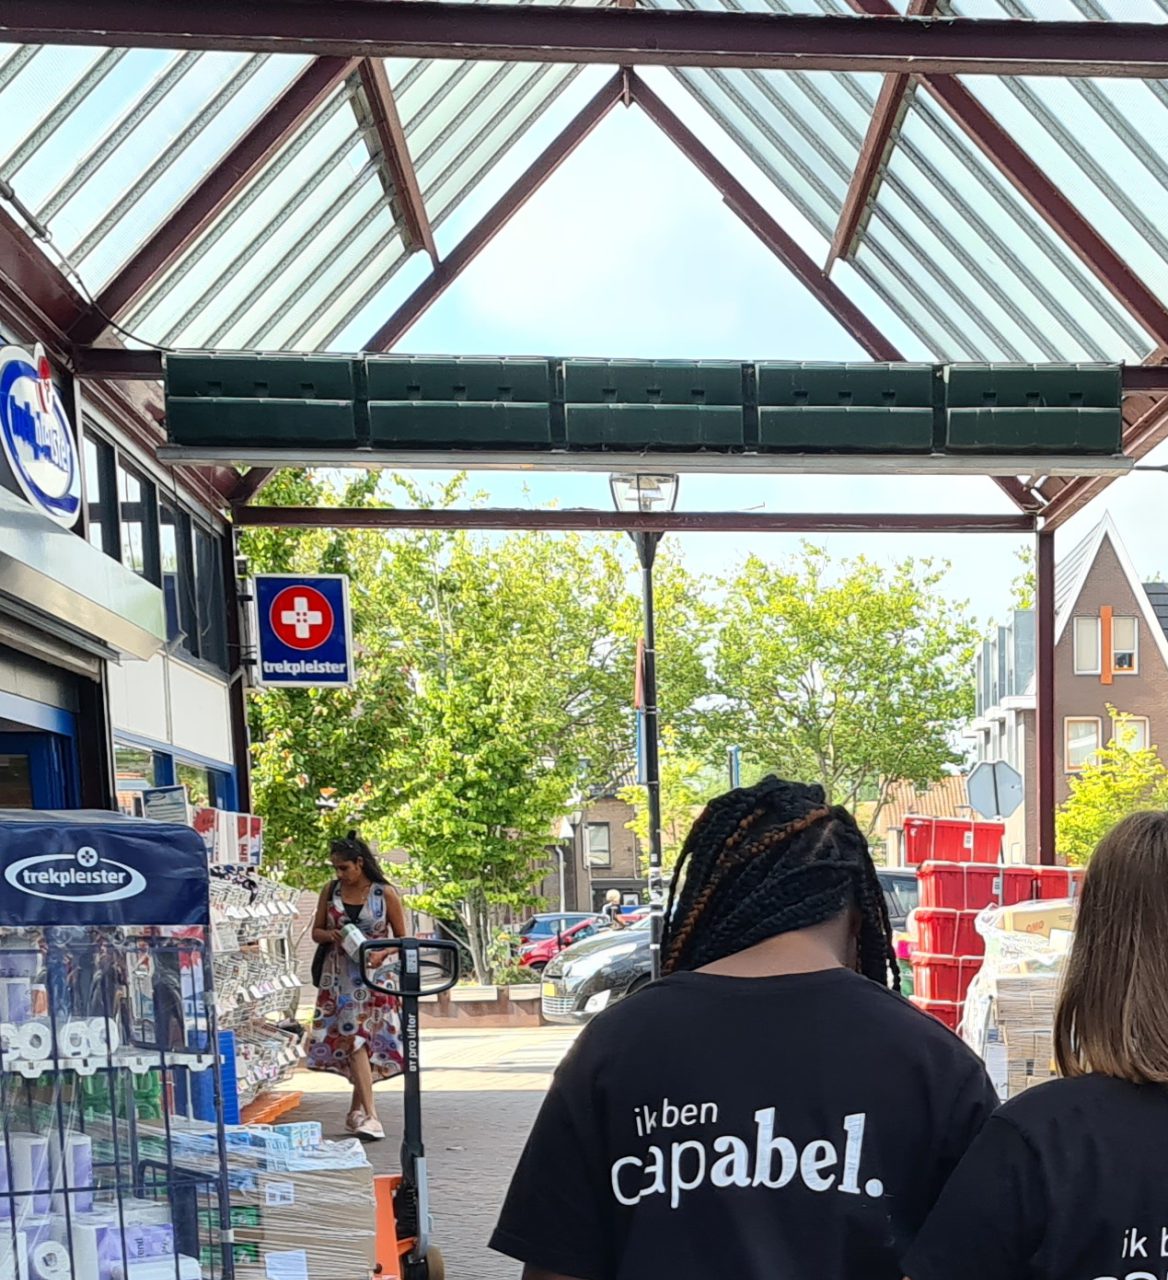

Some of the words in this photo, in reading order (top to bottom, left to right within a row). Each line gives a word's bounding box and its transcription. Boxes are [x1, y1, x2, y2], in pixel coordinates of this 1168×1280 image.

[262, 659, 347, 677] trekpleister
[22, 868, 127, 888] trekpleister
[634, 1105, 658, 1136] ik
[661, 1098, 718, 1128] ben
[611, 1104, 884, 1208] capabel.
[1121, 1228, 1148, 1258] ik
